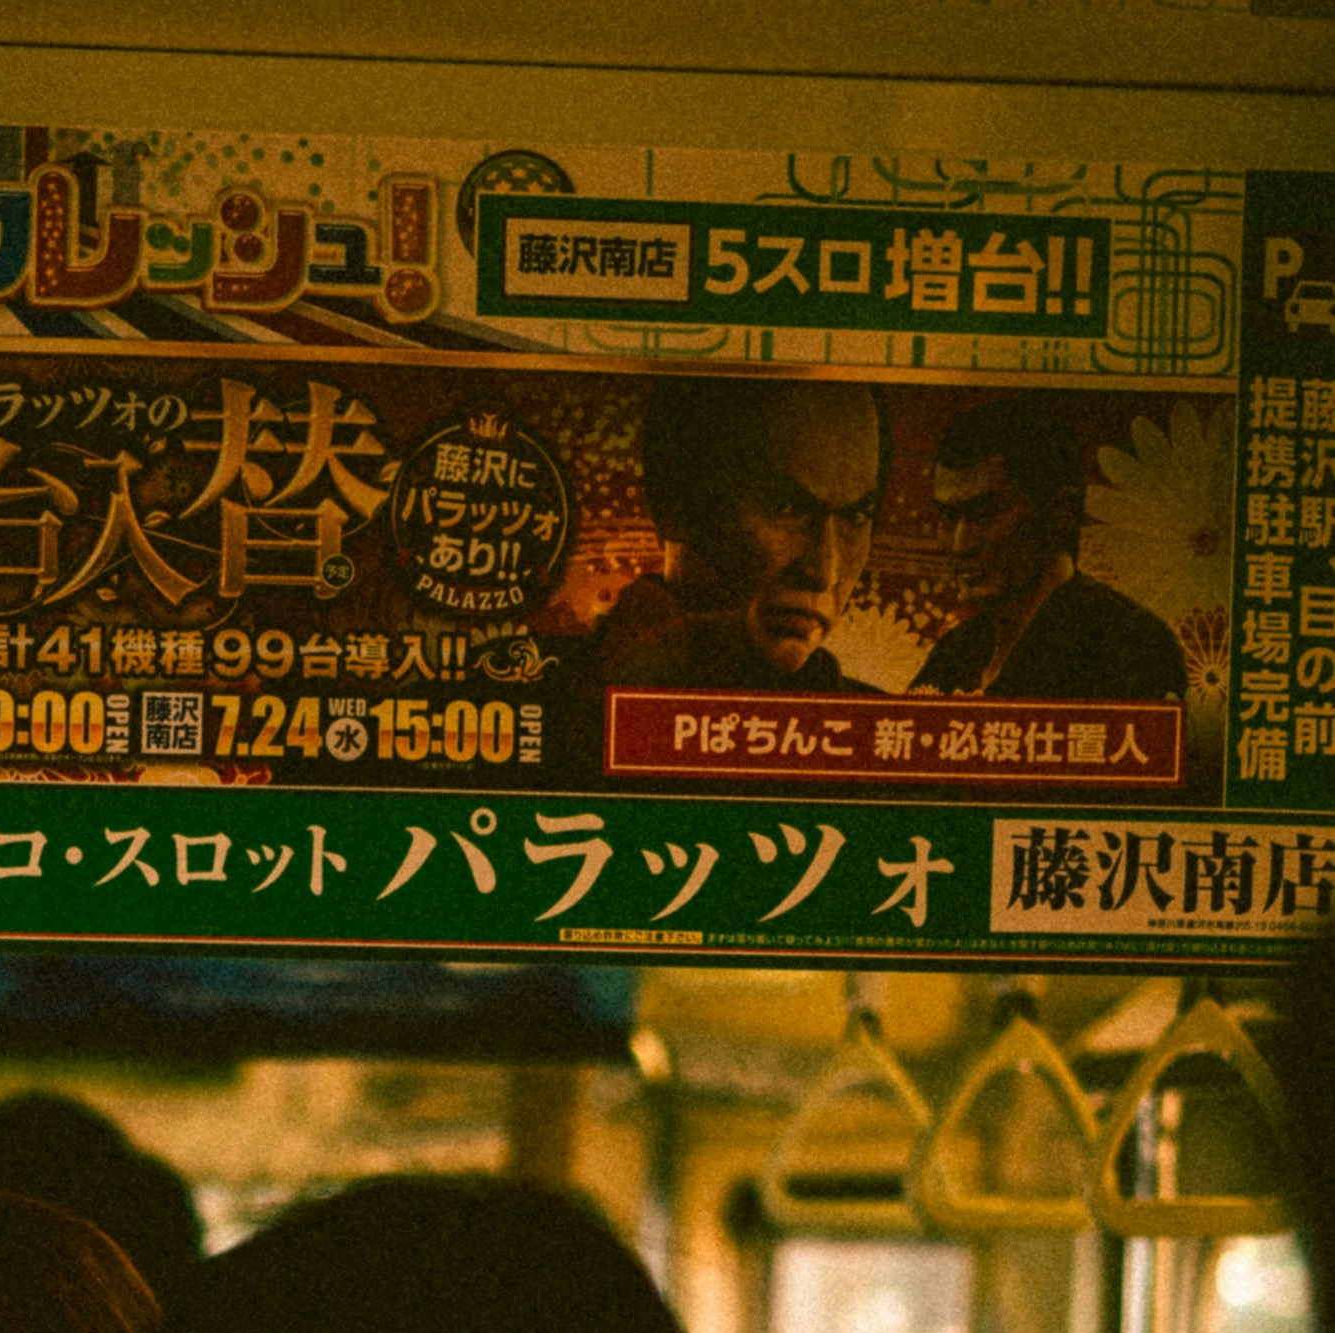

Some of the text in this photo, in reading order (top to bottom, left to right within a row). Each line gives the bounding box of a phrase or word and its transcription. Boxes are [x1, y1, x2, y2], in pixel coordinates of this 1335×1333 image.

[518, 232, 676, 280] 藤沢南店
[433, 441, 537, 489] 藤沢に
[401, 486, 559, 543] パラッツォ
[325, 563, 350, 579] 予定
[415, 573, 524, 611] PALAZZO
[1236, 374, 1298, 783] 提携駐車場完備
[105, 693, 130, 754] OPEN
[146, 697, 199, 724] 藤沢
[211, 694, 323, 758] 7.24
[328, 697, 365, 718] WED
[368, 699, 515, 763] 15:00
[516, 703, 543, 764] OPEN
[145, 724, 198, 751] 南店
[334, 724, 361, 752] 水
[672, 714, 1150, 766] Pぱちんこ 新・必殺仕置人
[374, 807, 956, 929] パラッツォ
[1007, 826, 1335, 917] 藤沢南店
